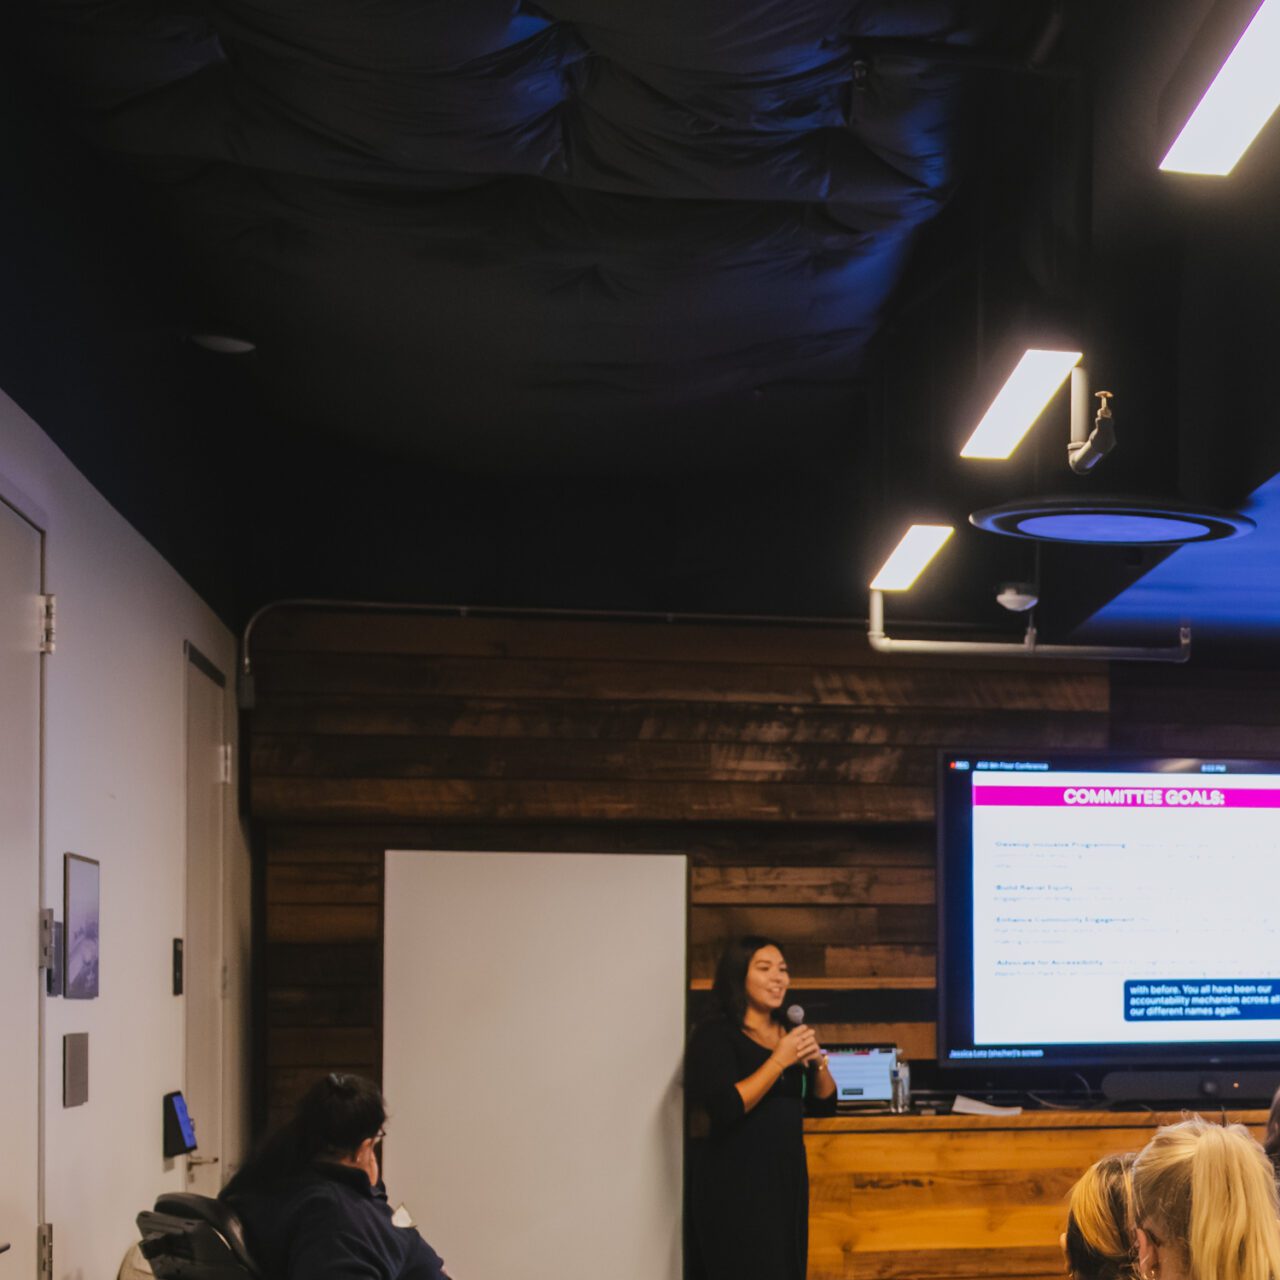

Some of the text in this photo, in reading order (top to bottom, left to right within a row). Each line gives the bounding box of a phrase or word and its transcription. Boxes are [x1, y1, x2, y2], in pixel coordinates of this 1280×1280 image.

[1063, 788, 1225, 806] COMMITTEE GOALS:
[1129, 986, 1149, 995] with
[1151, 985, 1181, 994] before.
[1183, 985, 1199, 994] You
[1200, 985, 1211, 994] all
[1212, 985, 1233, 994] have
[1234, 985, 1256, 993] been
[1129, 996, 1190, 1007] accountability
[1191, 995, 1240, 1005] mechanism
[1241, 996, 1269, 1005] across
[1270, 995, 1280, 1004] all
[1130, 1008, 1145, 1016] our
[1146, 1006, 1183, 1016] different
[1215, 1007, 1241, 1017] again.
